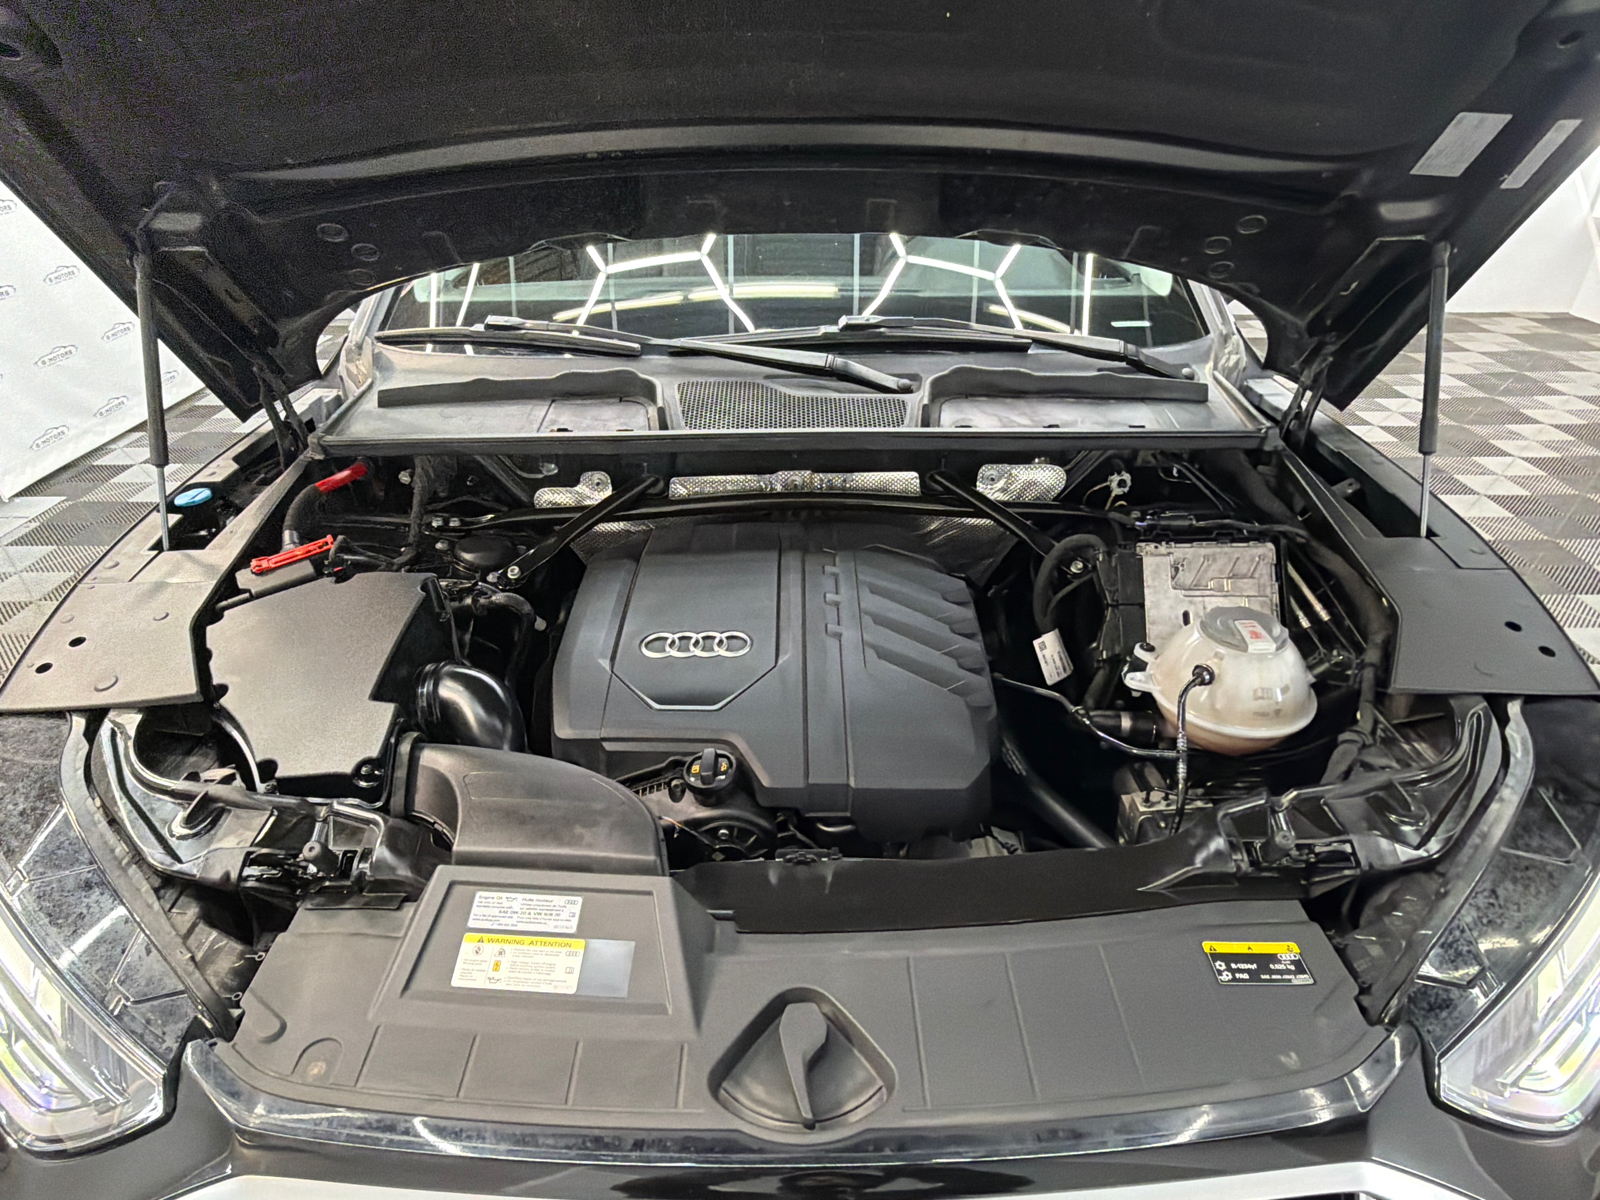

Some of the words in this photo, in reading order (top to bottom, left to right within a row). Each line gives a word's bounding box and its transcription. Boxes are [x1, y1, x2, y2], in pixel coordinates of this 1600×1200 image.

[48, 350, 73, 363] MOTORS
[42, 430, 66, 445] MOTORS
[487, 937, 525, 945] WARNING
[528, 940, 572, 948] ATTENTION
